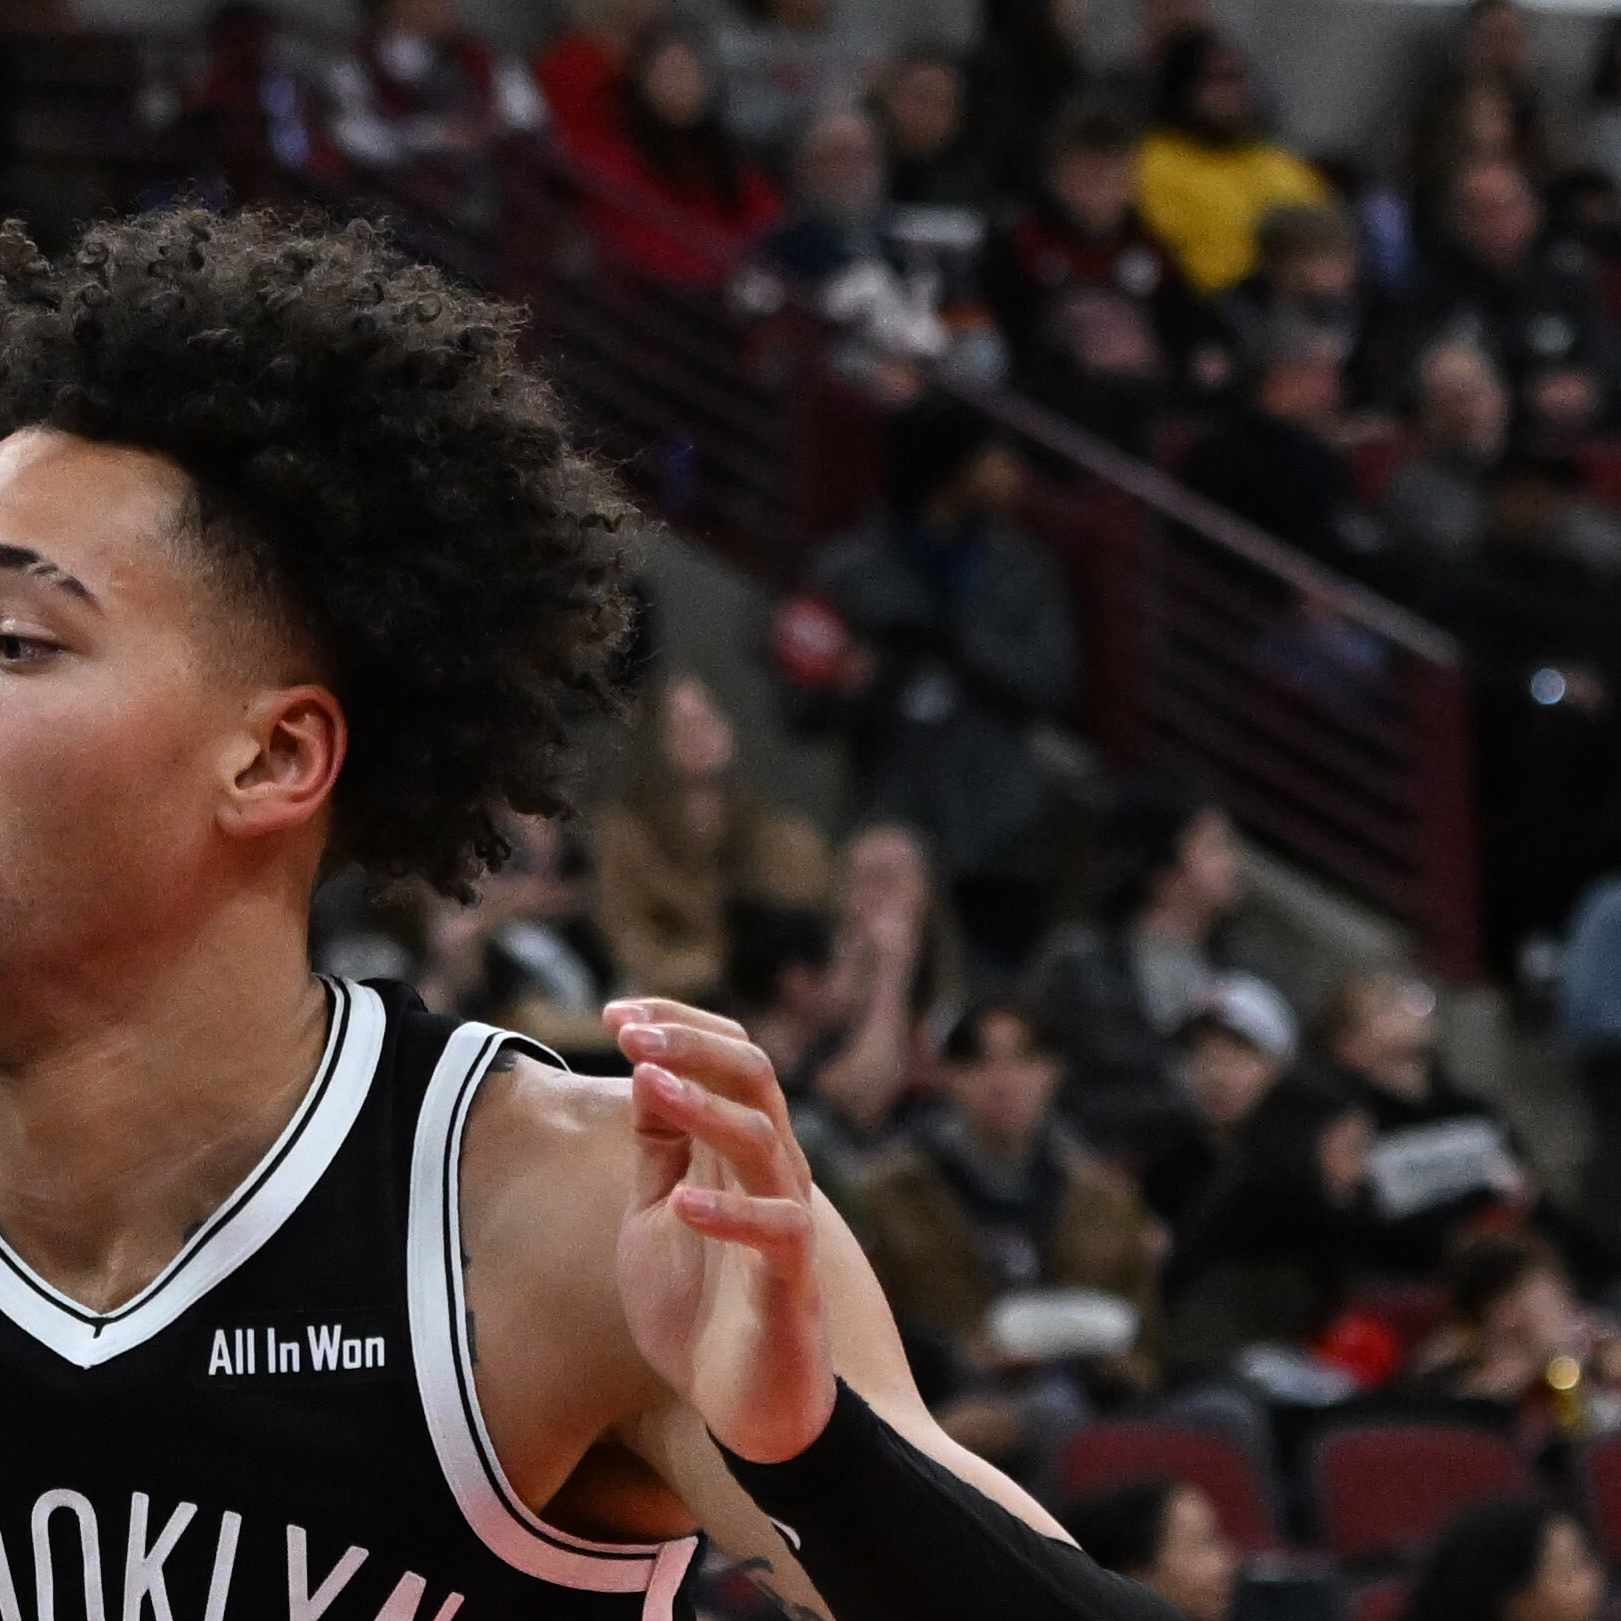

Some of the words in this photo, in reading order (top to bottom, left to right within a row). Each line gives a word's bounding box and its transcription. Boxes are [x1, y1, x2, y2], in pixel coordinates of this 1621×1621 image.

[207, 1328, 257, 1377] All
[266, 1326, 301, 1374] In
[306, 1323, 386, 1372] Won
